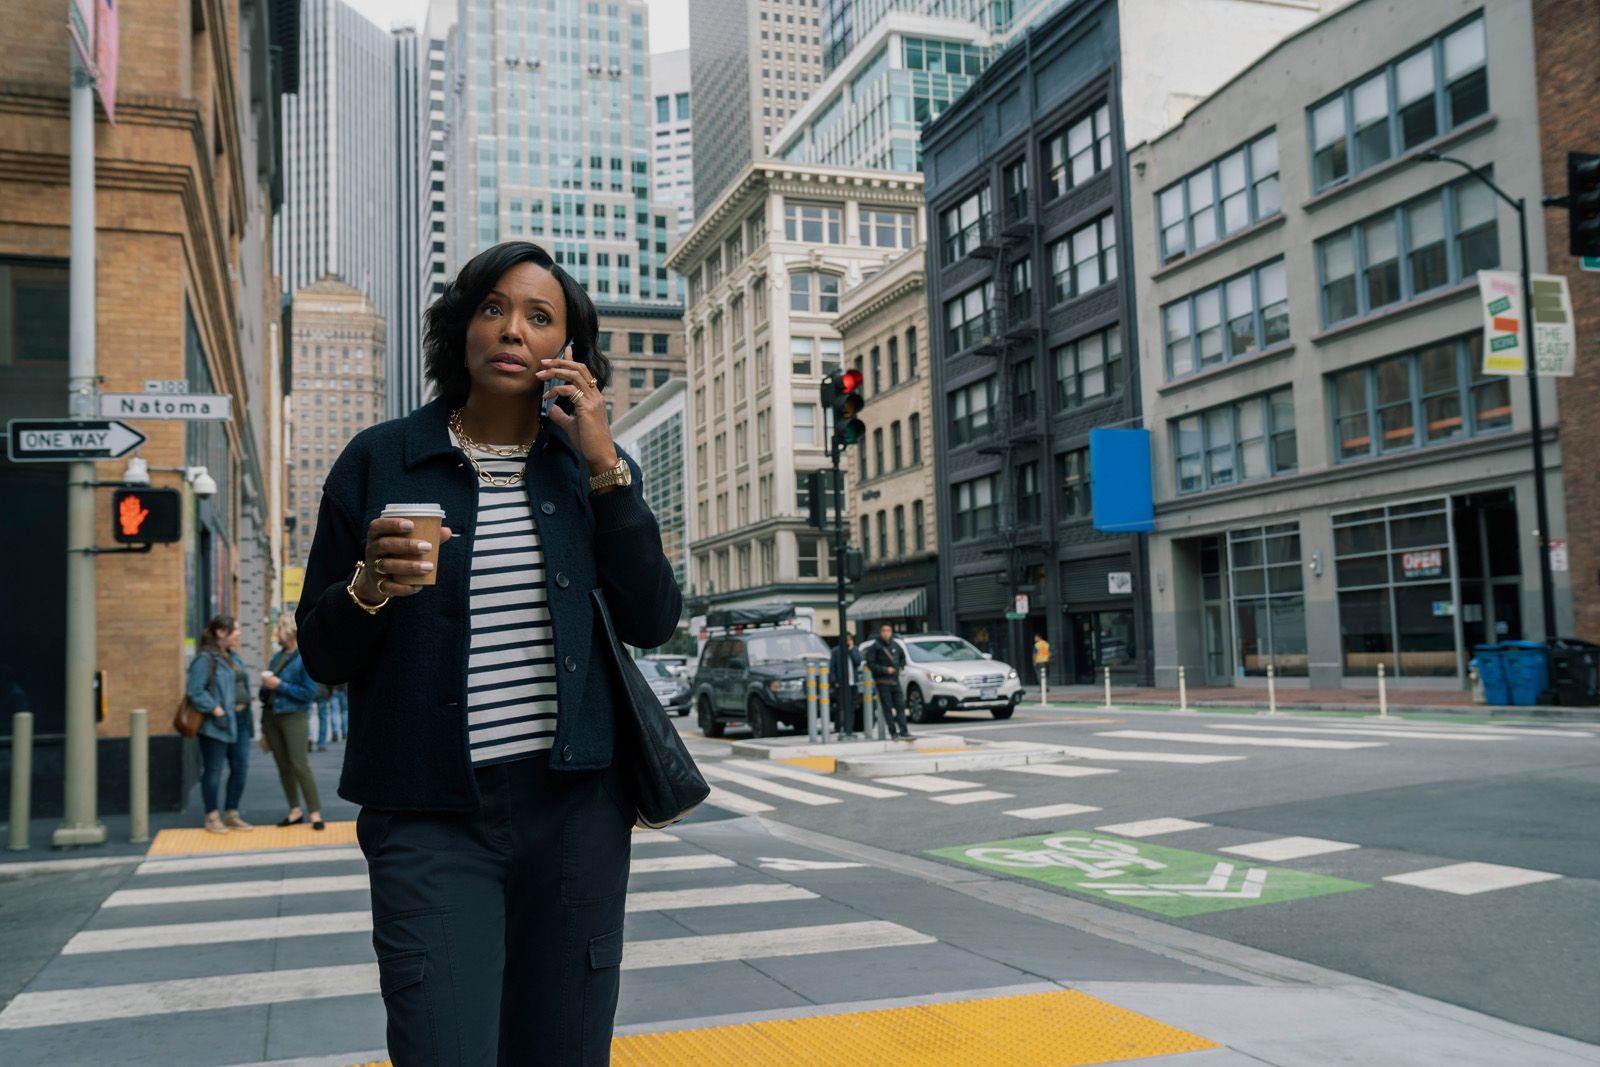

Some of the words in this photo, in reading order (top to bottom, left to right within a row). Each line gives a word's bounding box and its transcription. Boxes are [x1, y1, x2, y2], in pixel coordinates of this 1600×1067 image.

[121, 399, 211, 414] Natoma
[26, 433, 65, 448] ONE
[70, 432, 108, 447] WAY
[1403, 550, 1442, 569] OPEN
